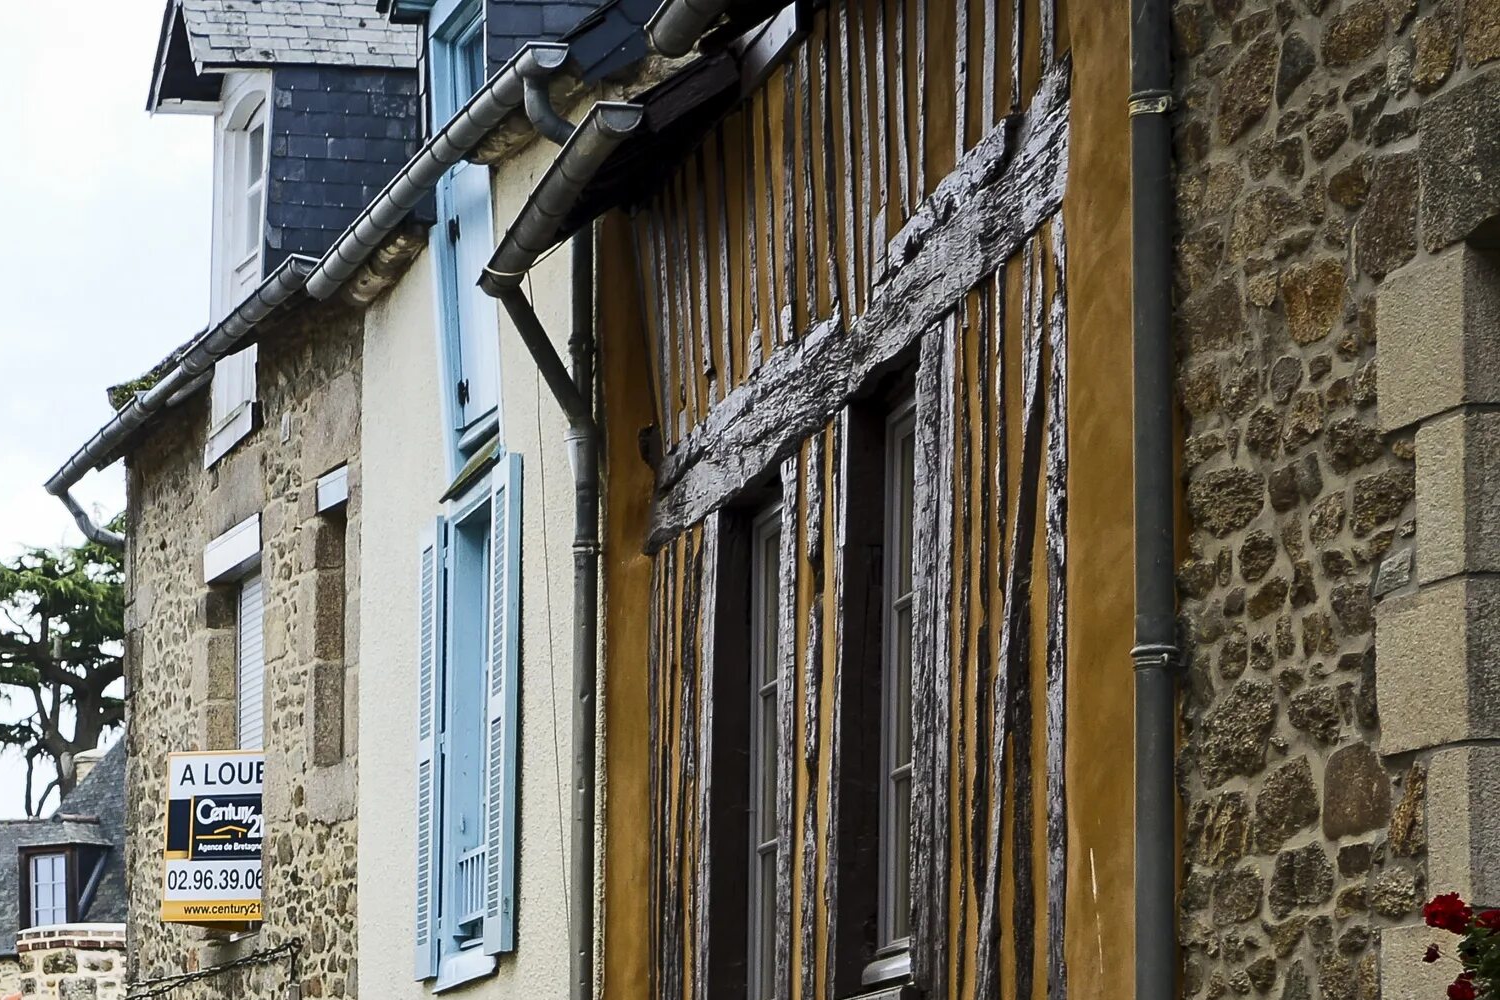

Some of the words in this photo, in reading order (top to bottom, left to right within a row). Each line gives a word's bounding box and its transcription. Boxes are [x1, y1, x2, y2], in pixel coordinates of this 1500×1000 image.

[180, 764, 195, 785] A
[196, 798, 255, 825] Century
[247, 814, 264, 838] 21
[198, 843, 222, 853] Agence
[224, 842, 232, 851] de
[184, 903, 261, 916] www.century21
